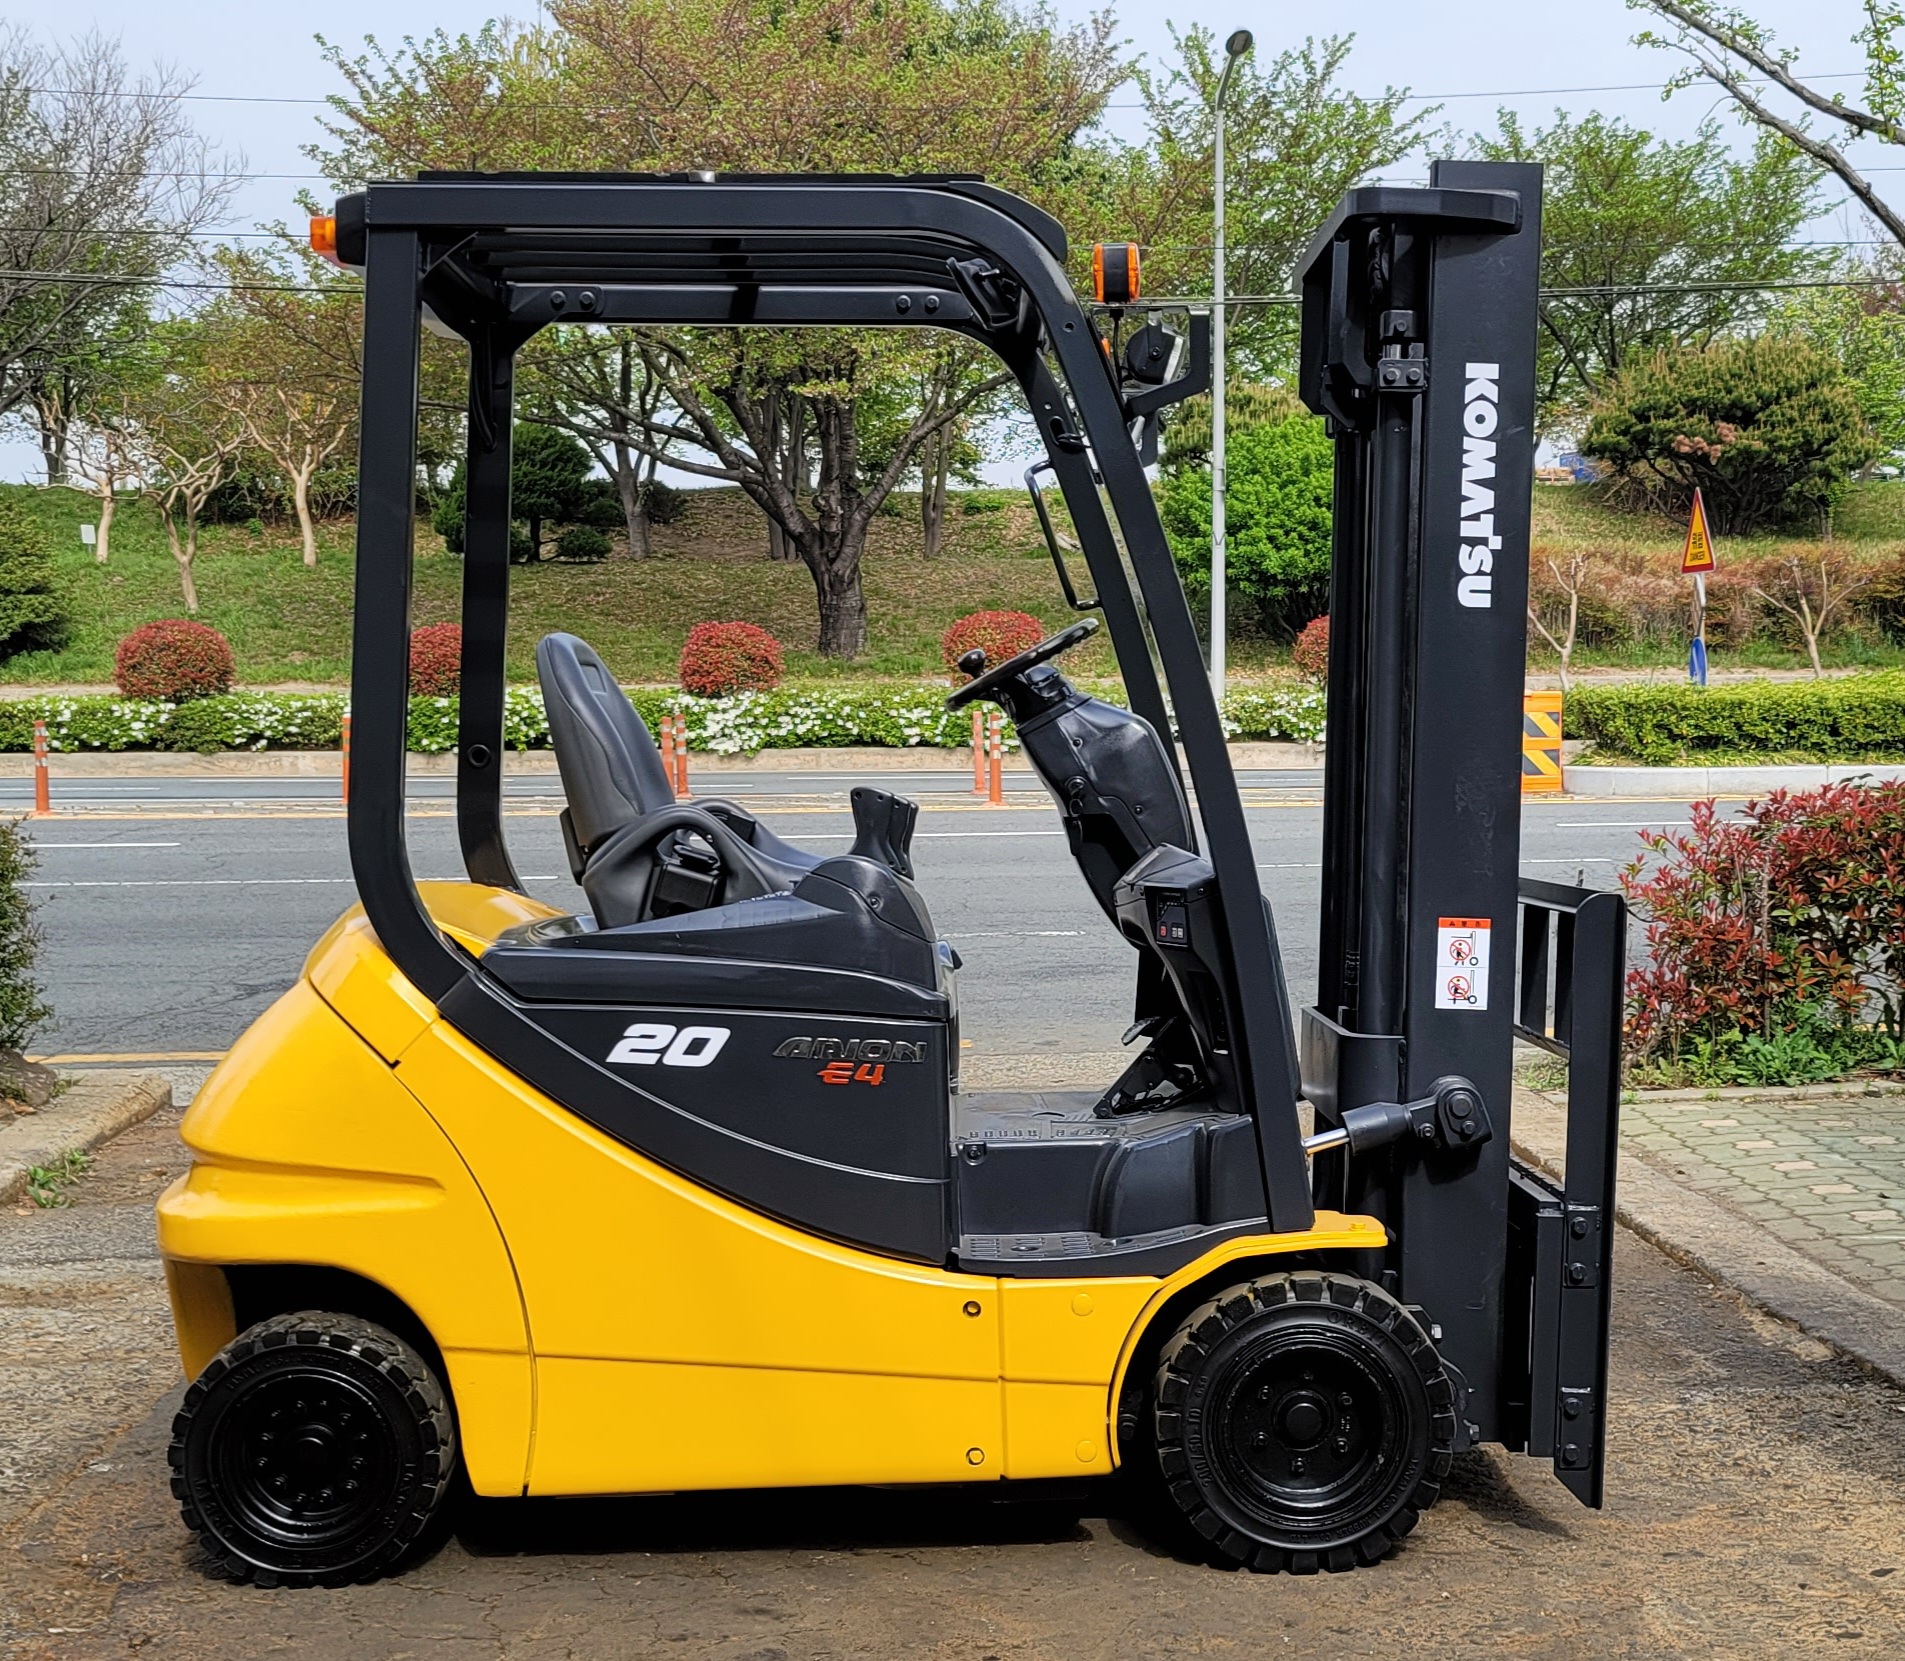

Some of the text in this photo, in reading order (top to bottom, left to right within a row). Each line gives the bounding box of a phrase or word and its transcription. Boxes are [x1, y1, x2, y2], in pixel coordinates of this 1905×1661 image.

[1457, 362, 1502, 608] KOMATSU
[605, 1023, 731, 1067] 20
[772, 1036, 928, 1063] ARION
[817, 1061, 885, 1086] E4
[1327, 1310, 1389, 1348] ORBIT
